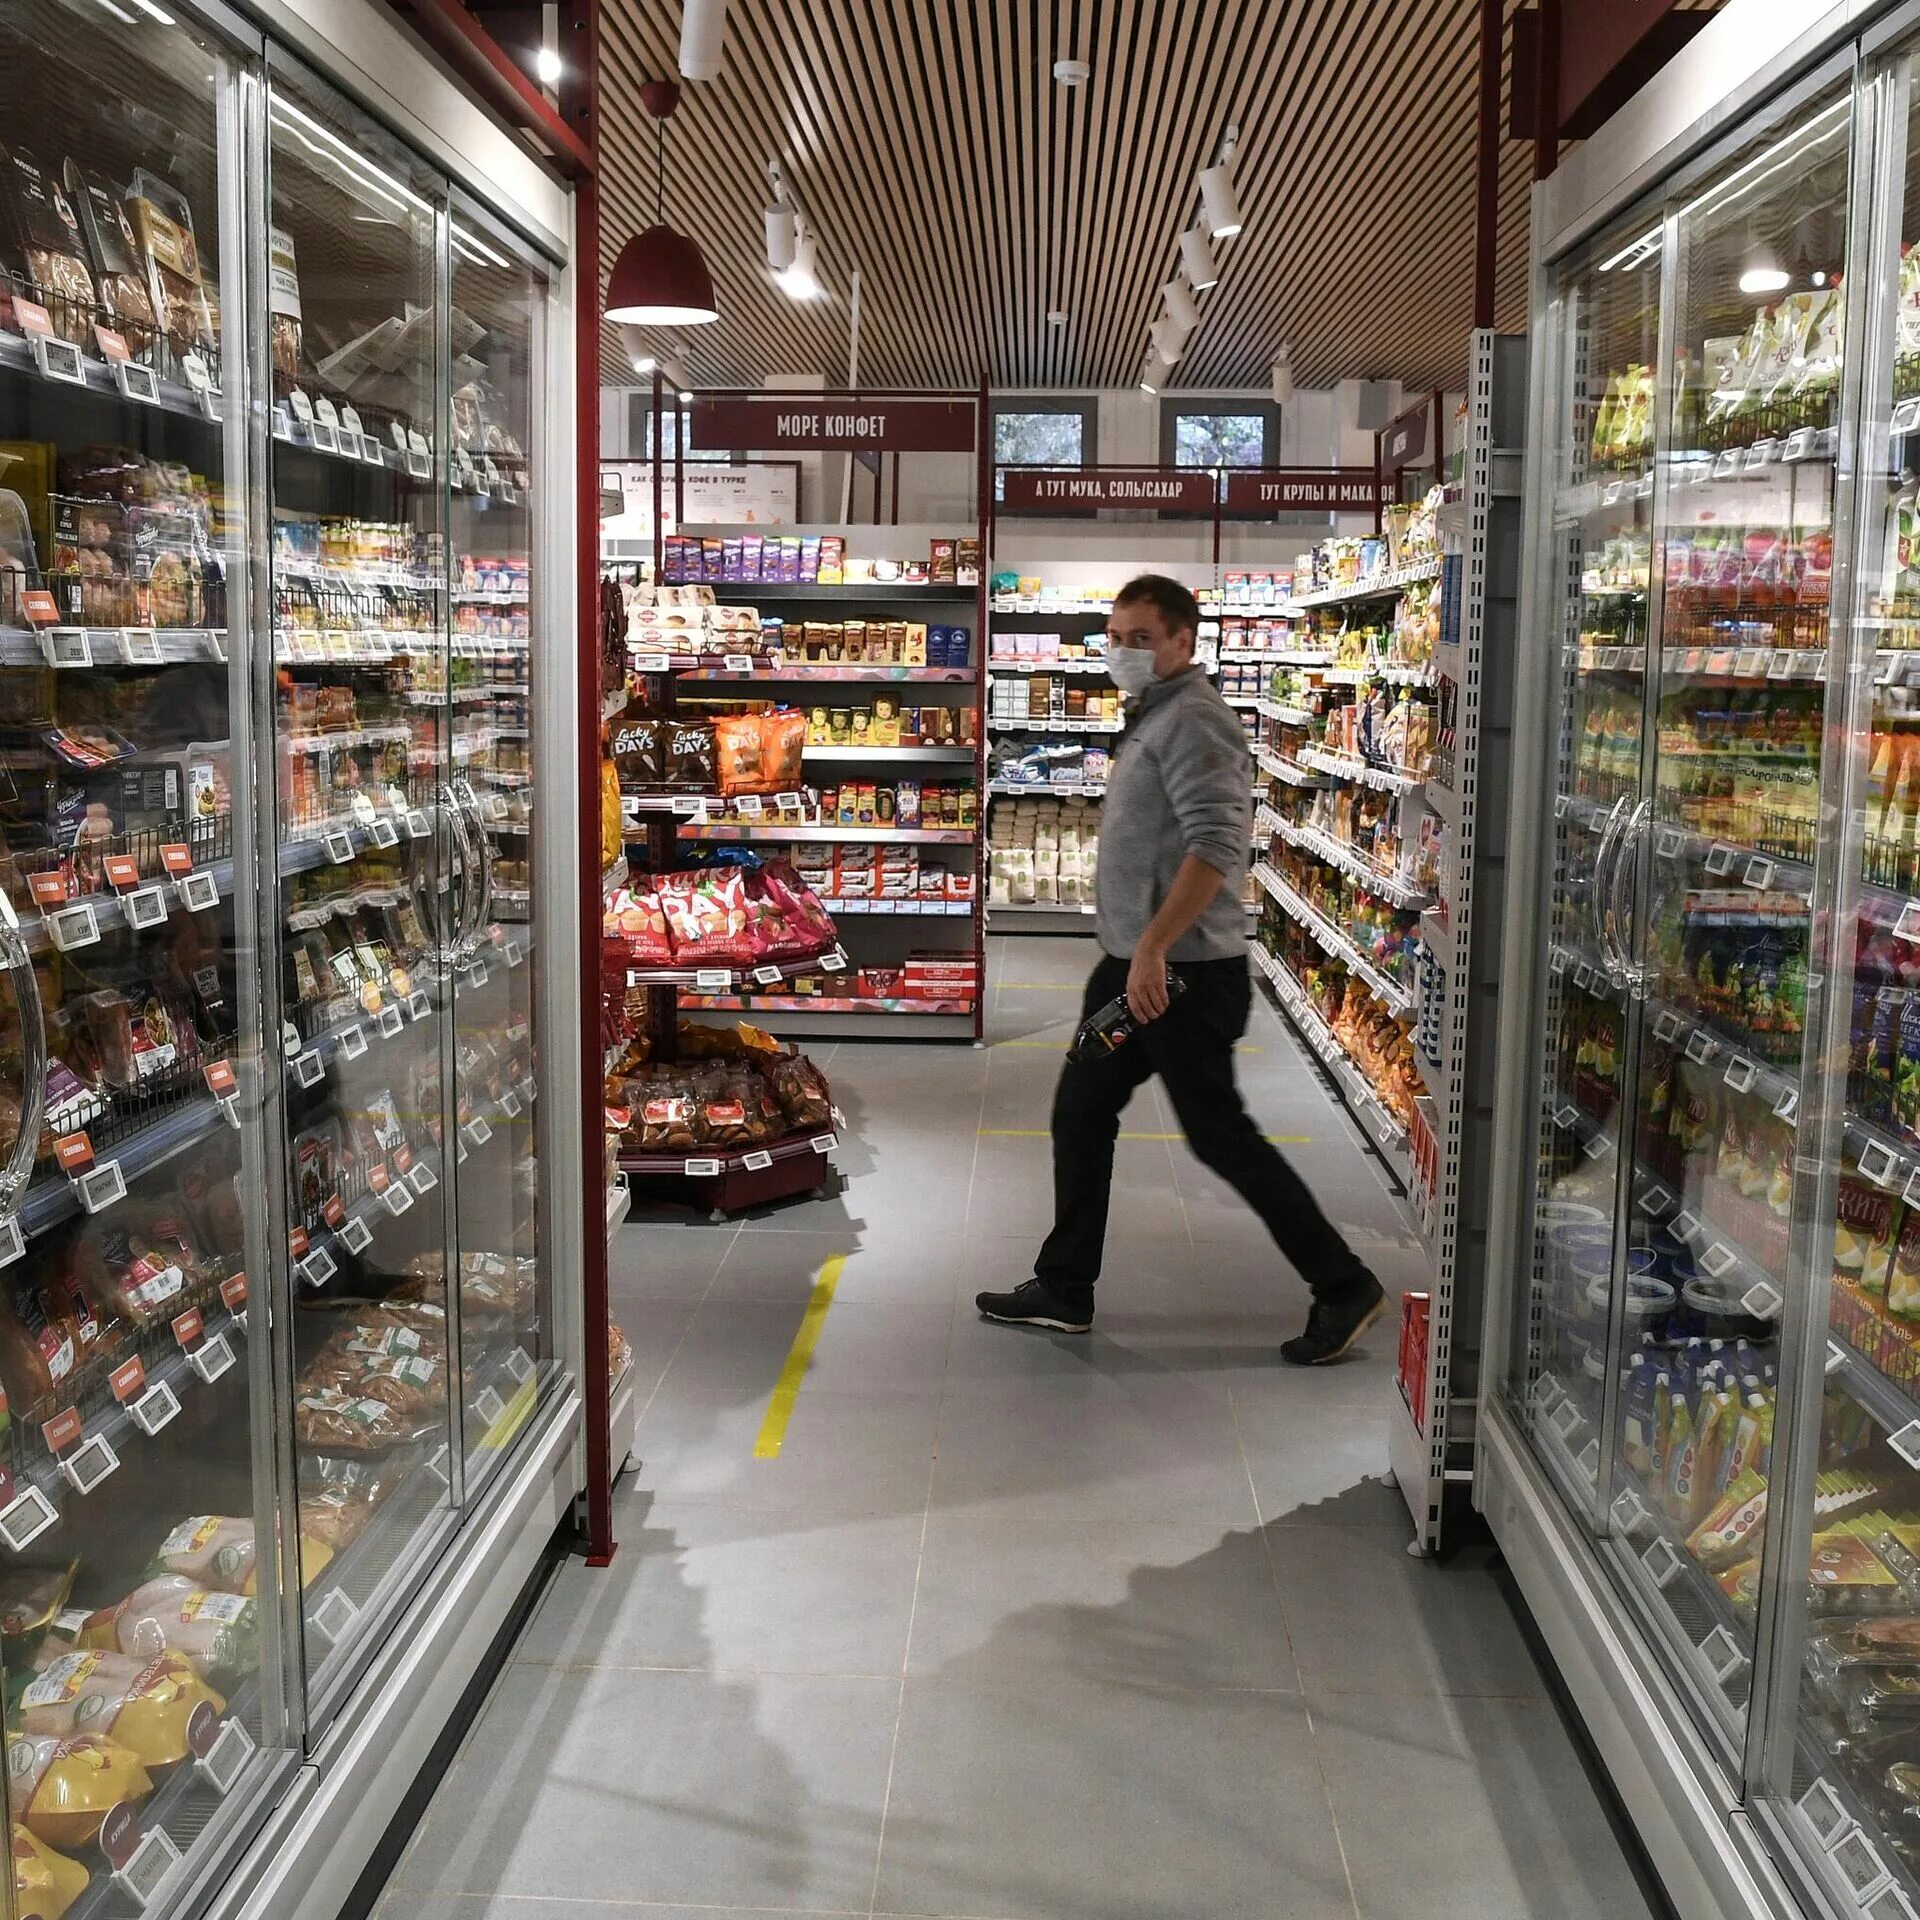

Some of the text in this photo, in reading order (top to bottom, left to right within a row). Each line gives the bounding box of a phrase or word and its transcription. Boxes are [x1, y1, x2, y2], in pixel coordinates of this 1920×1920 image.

[777, 415, 886, 437] МОРЕ КОНФЕТ
[688, 476, 710, 484] КОФЕ
[721, 476, 746, 485] ТУРКЕ
[1035, 480, 1183, 499] А ТУТ МУКА, СОЛЬ/САХАР
[1260, 484, 1396, 502] ТУТ КРУПЫ И МАКАОН
[616, 726, 650, 743] Lucky
[672, 730, 706, 745] Lucky
[615, 737, 655, 754] DAYS
[672, 738, 711, 755] DAYS
